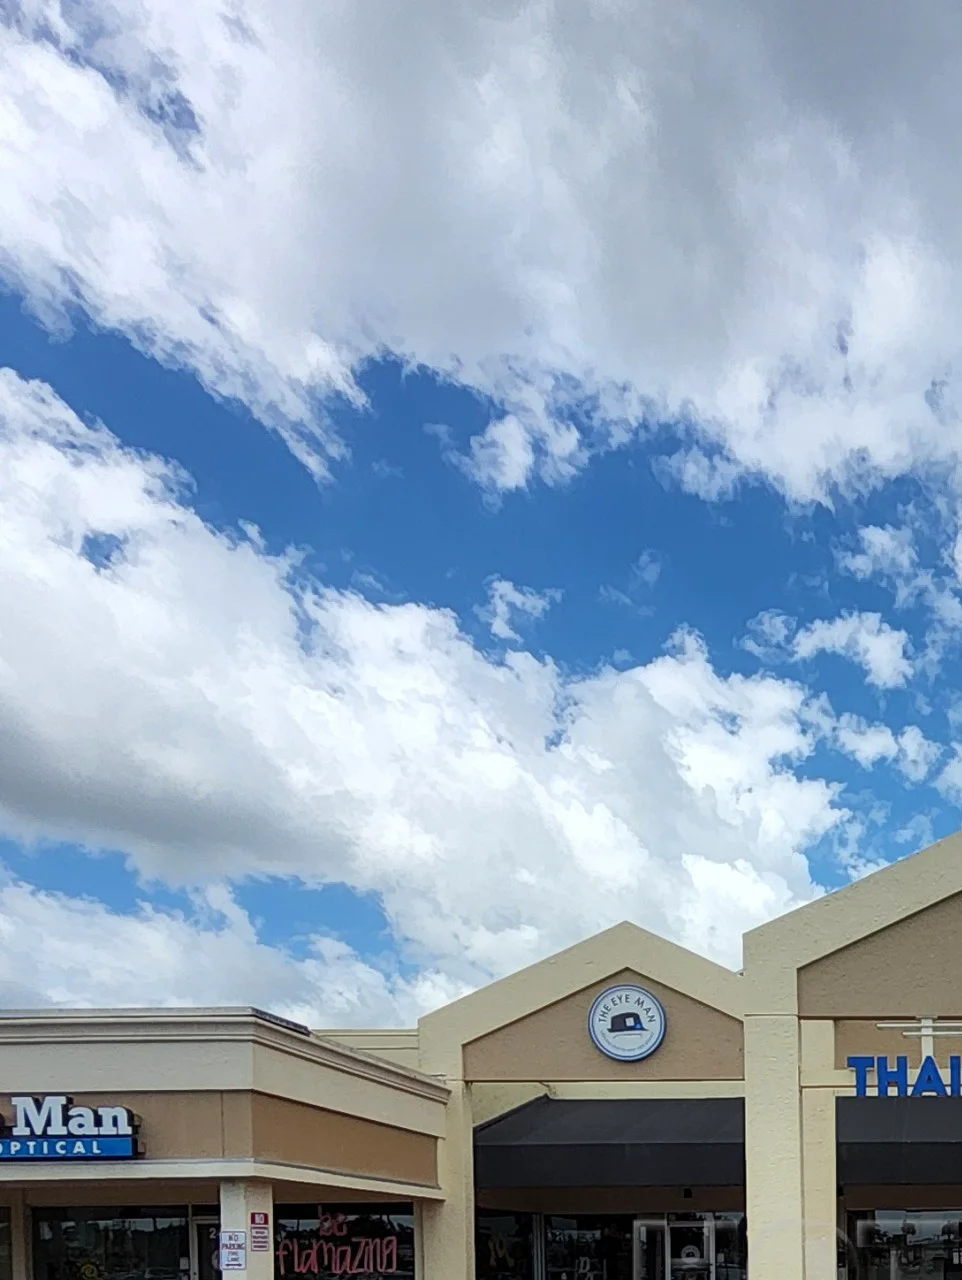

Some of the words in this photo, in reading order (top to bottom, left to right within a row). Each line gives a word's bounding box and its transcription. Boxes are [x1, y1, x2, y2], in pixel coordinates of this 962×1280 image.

[598, 1004, 611, 1022] THE
[611, 994, 631, 1006] EYE
[634, 997, 656, 1023] MAN
[847, 1056, 962, 1097] THAI
[11, 1096, 133, 1136] Man
[0, 1141, 102, 1155] PTICAL
[221, 1242, 246, 1250] PARKING
[228, 1234, 239, 1242] NO
